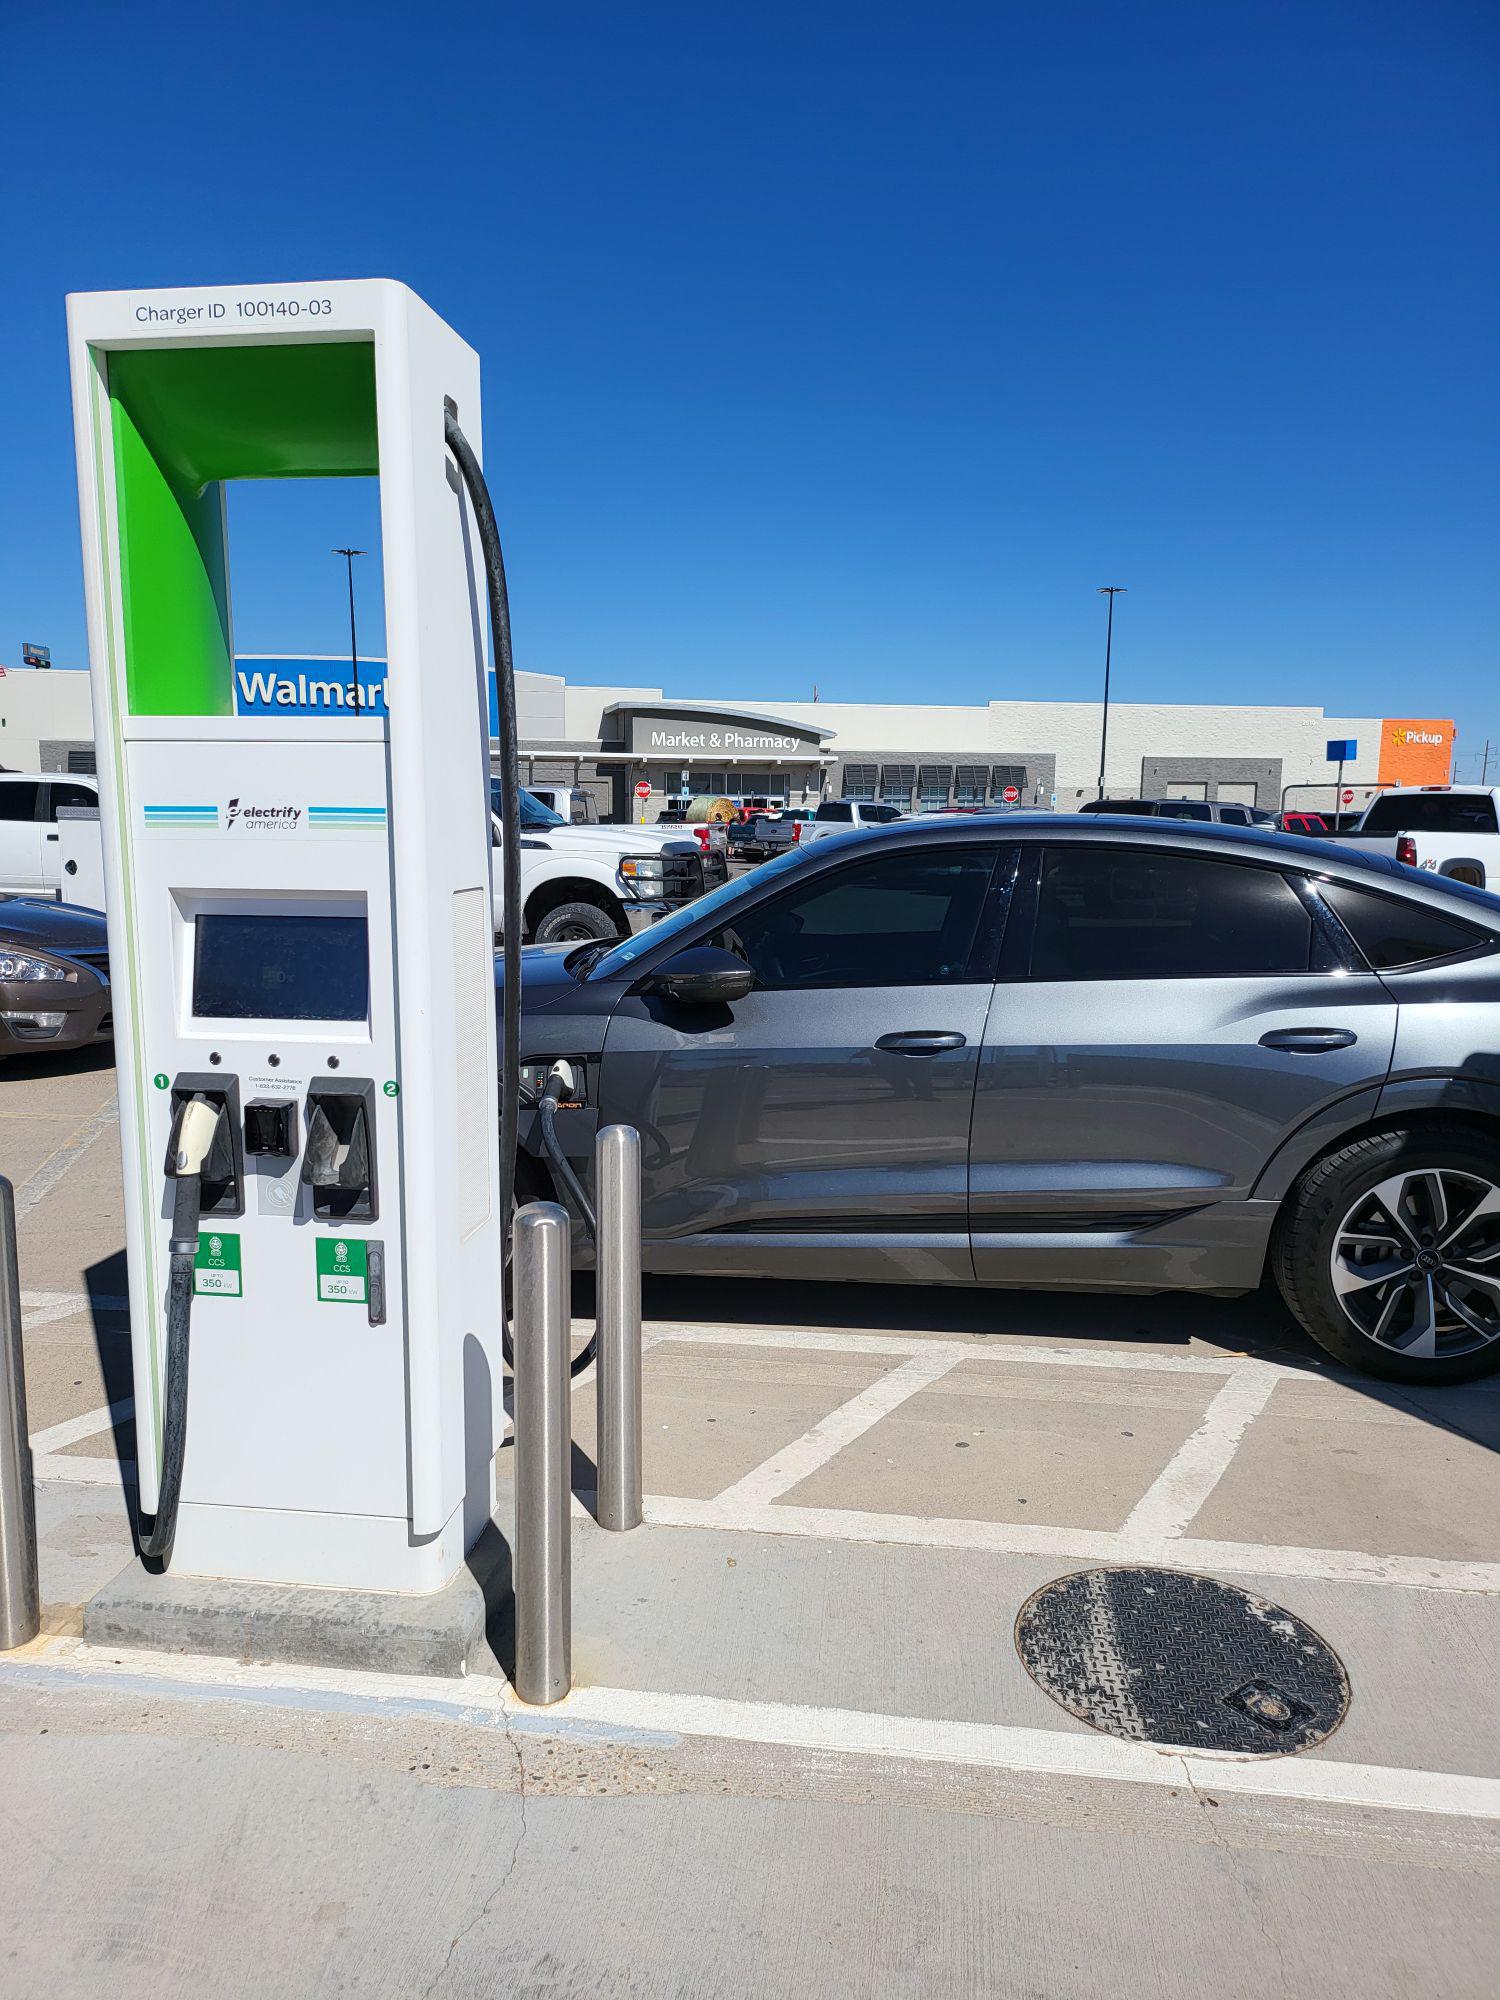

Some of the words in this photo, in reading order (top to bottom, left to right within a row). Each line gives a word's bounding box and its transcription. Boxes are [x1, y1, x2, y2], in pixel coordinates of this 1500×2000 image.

[136, 306, 204, 325] Charger
[208, 303, 226, 319] ID
[236, 299, 333, 317] 100140-03
[651, 731, 706, 747] Market
[709, 732, 722, 748] &
[724, 732, 800, 753] Pharmacy
[1406, 730, 1443, 746] Pickup
[636, 786, 650, 794] STOP
[243, 806, 302, 820] electrify
[245, 819, 298, 830] america
[158, 1076, 165, 1088] 1
[386, 1083, 397, 1095] 2
[207, 1258, 226, 1267] CCS
[333, 1264, 351, 1273] CCS
[202, 1278, 222, 1288] 350
[327, 1284, 347, 1294] 350
